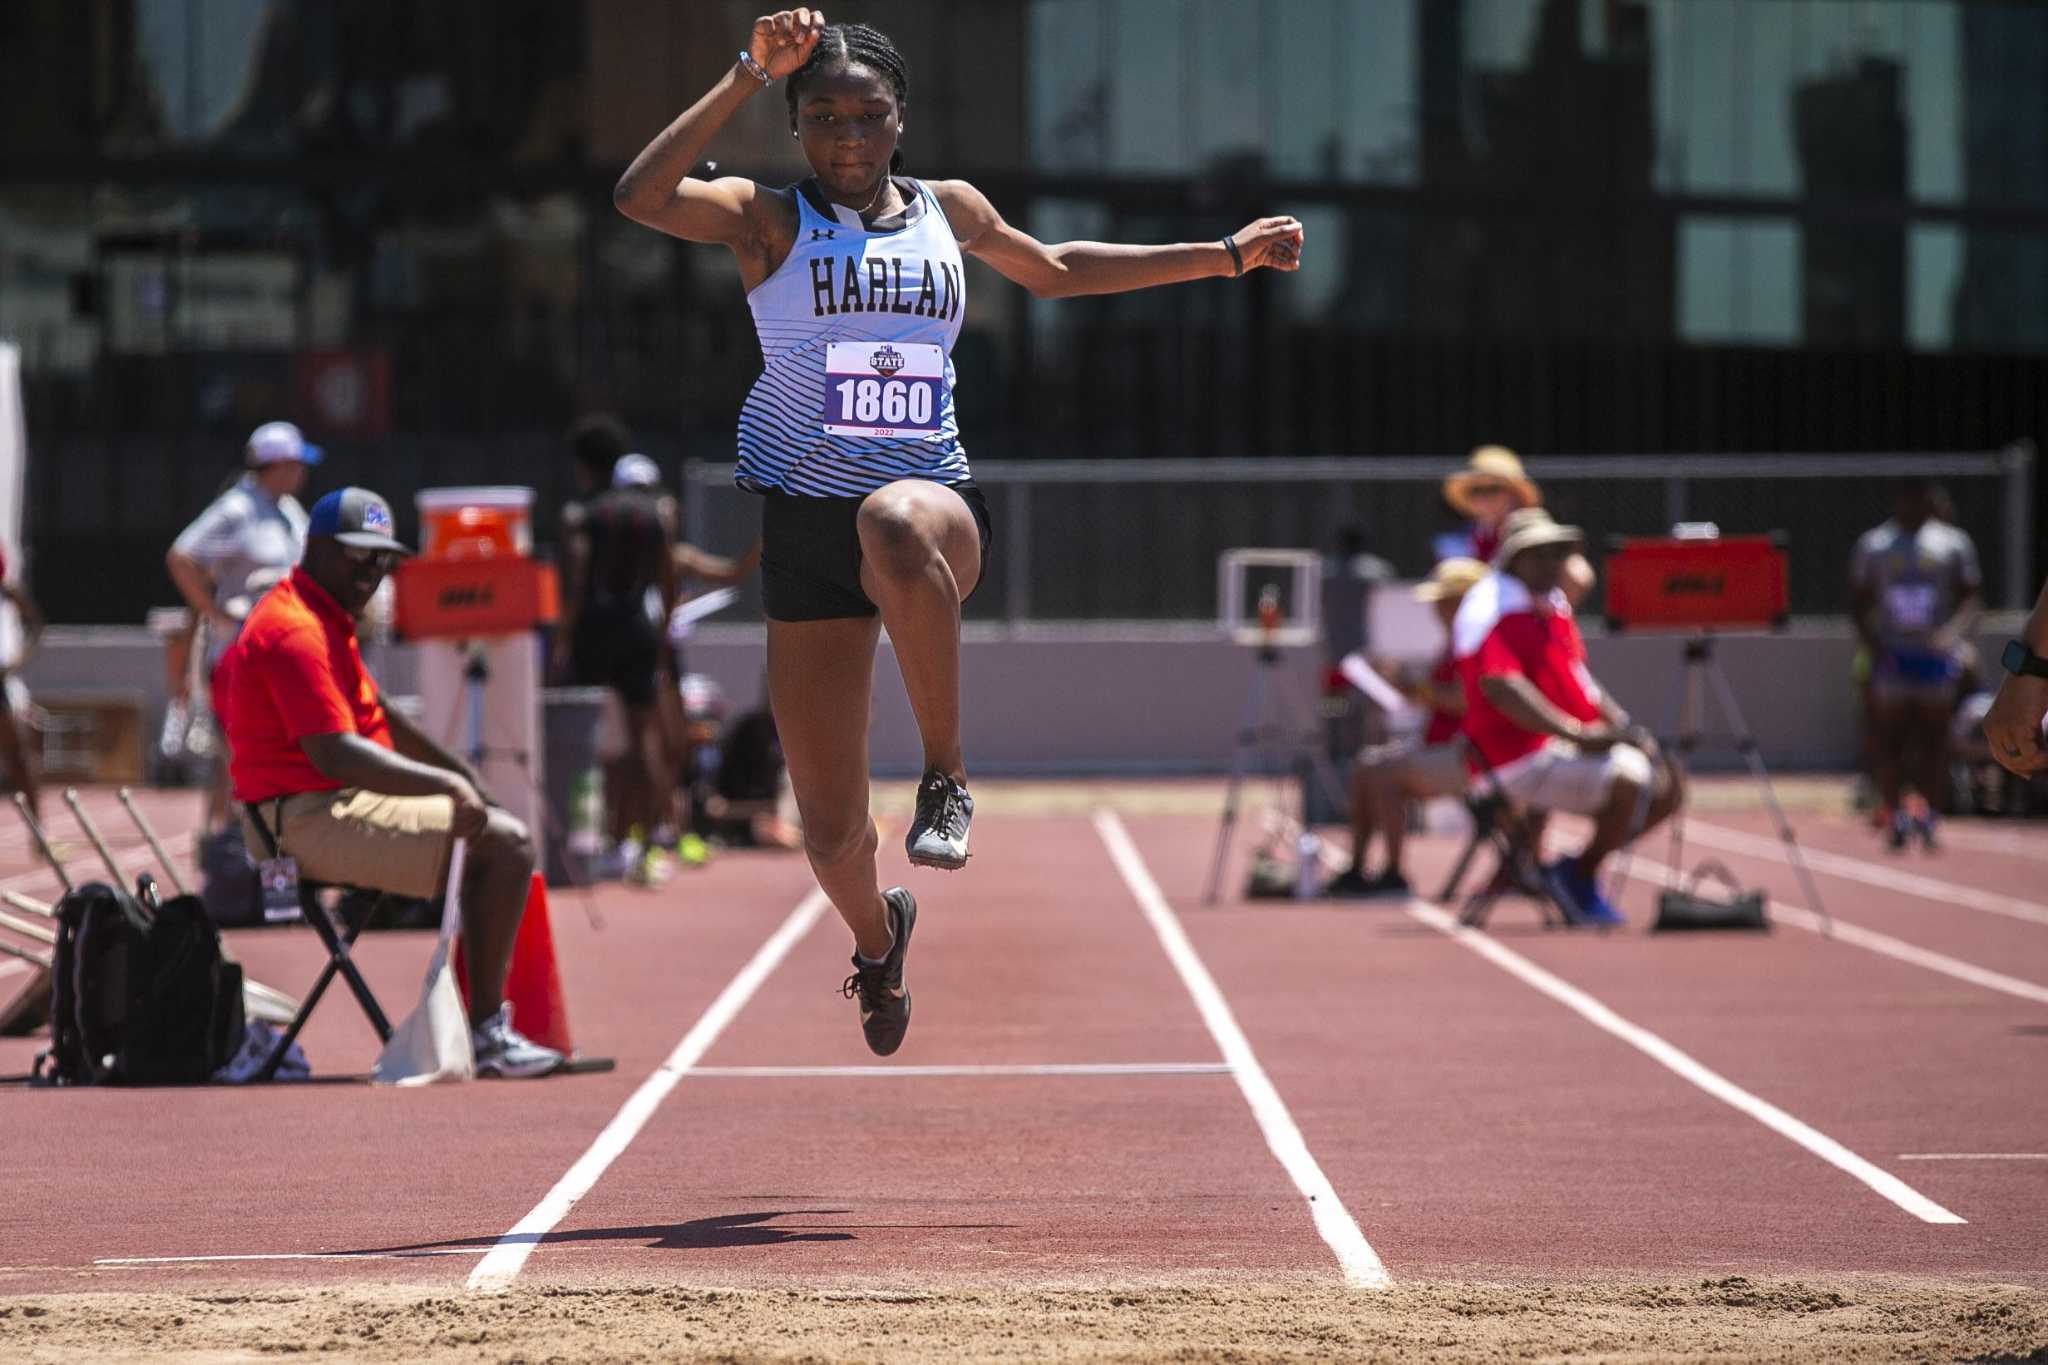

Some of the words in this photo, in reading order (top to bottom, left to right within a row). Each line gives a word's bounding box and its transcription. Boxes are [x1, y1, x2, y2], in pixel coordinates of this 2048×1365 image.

[809, 256, 960, 322] HARLAN
[870, 357, 904, 367] STATE
[836, 379, 932, 424] 1860
